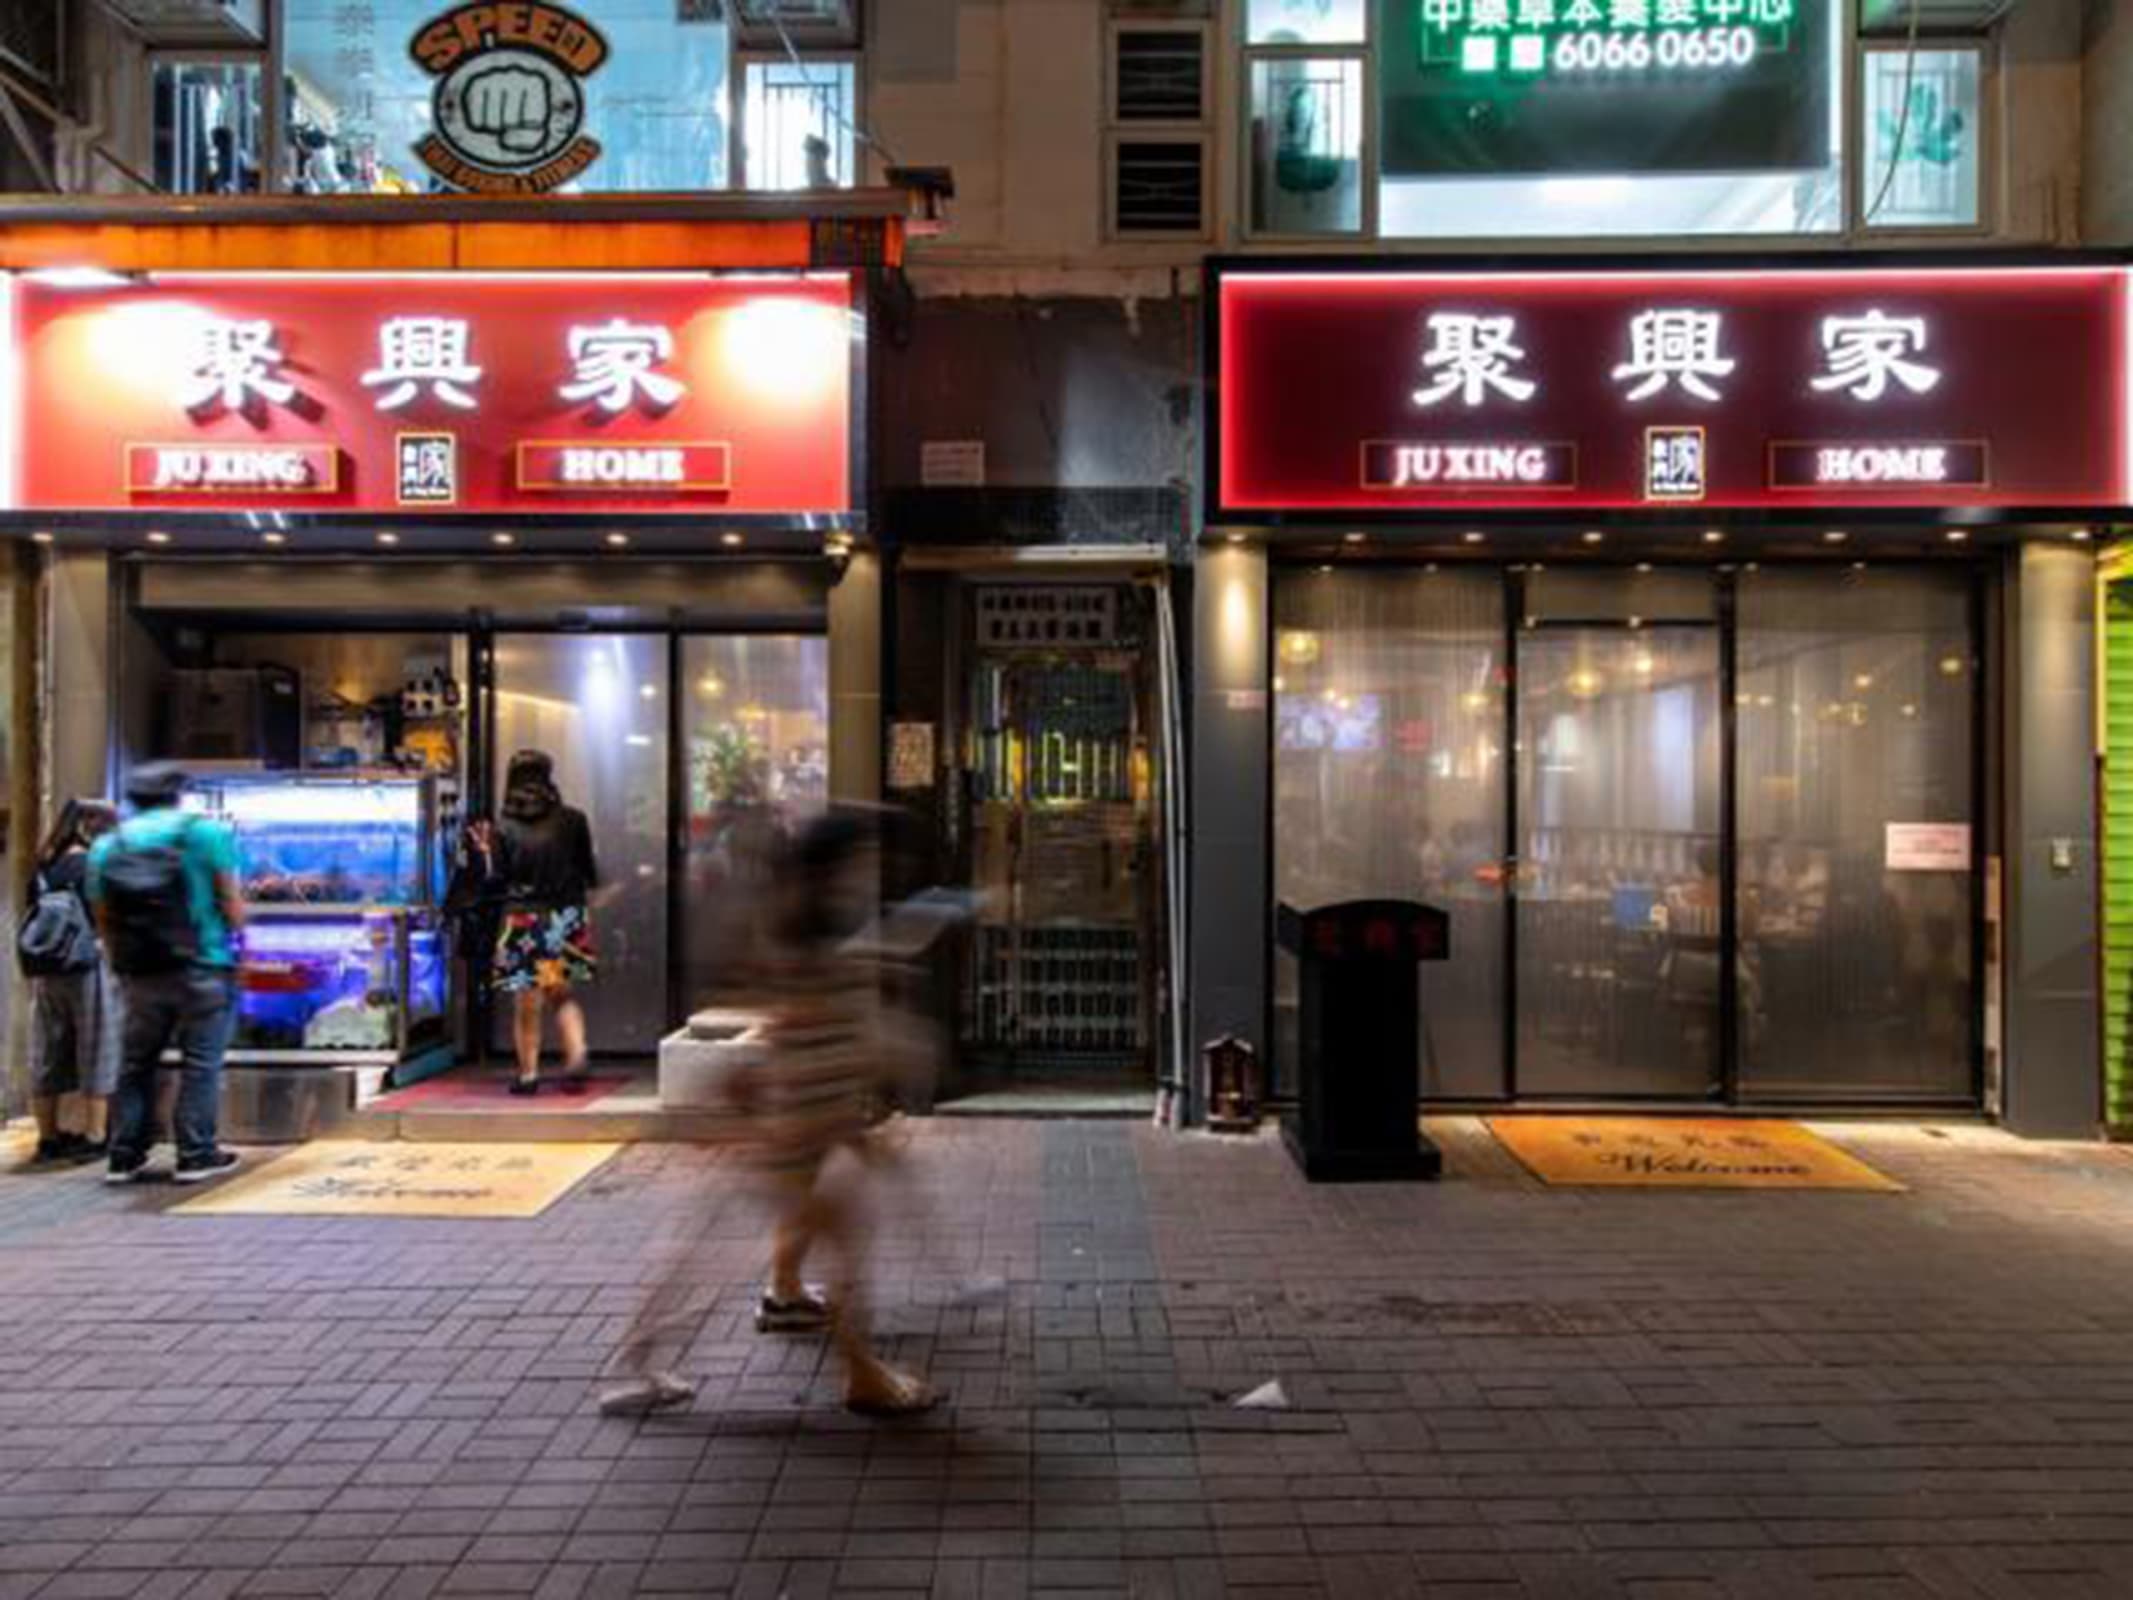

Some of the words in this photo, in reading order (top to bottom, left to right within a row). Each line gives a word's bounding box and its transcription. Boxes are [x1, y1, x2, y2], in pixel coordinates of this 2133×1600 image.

[412, 3, 602, 72] SPEED
[1554, 29, 1652, 70] 6066
[1655, 25, 1756, 67] 0650
[181, 316, 686, 411] 聚興家
[1411, 308, 1942, 406] 聚興家
[562, 447, 685, 482] HOME
[1816, 447, 1947, 482] HOME
